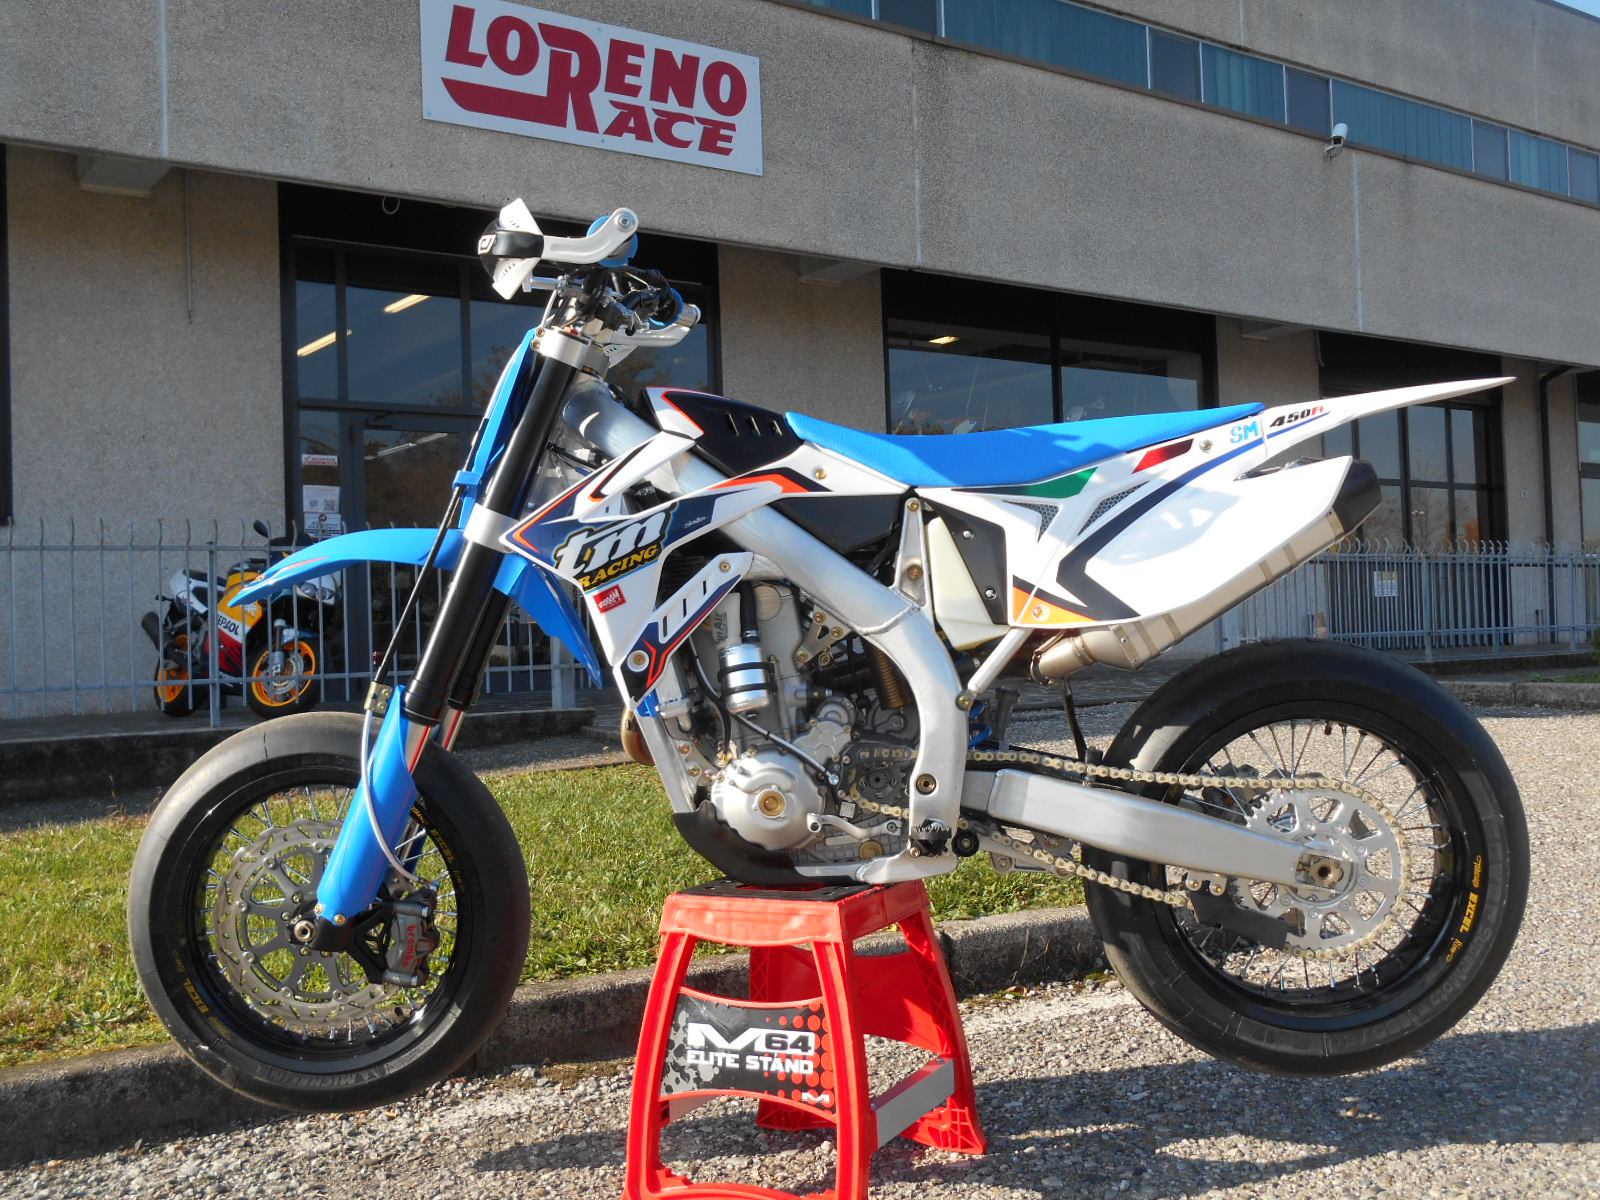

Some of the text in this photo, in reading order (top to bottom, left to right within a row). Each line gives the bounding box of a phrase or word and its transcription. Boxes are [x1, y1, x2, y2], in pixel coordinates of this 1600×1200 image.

[444, 4, 748, 126] LORENO
[1230, 420, 1258, 443] SM
[578, 543, 658, 593] RACING
[1459, 892, 1479, 933] EXCEL
[686, 1050, 814, 1075] ELITE STAND
